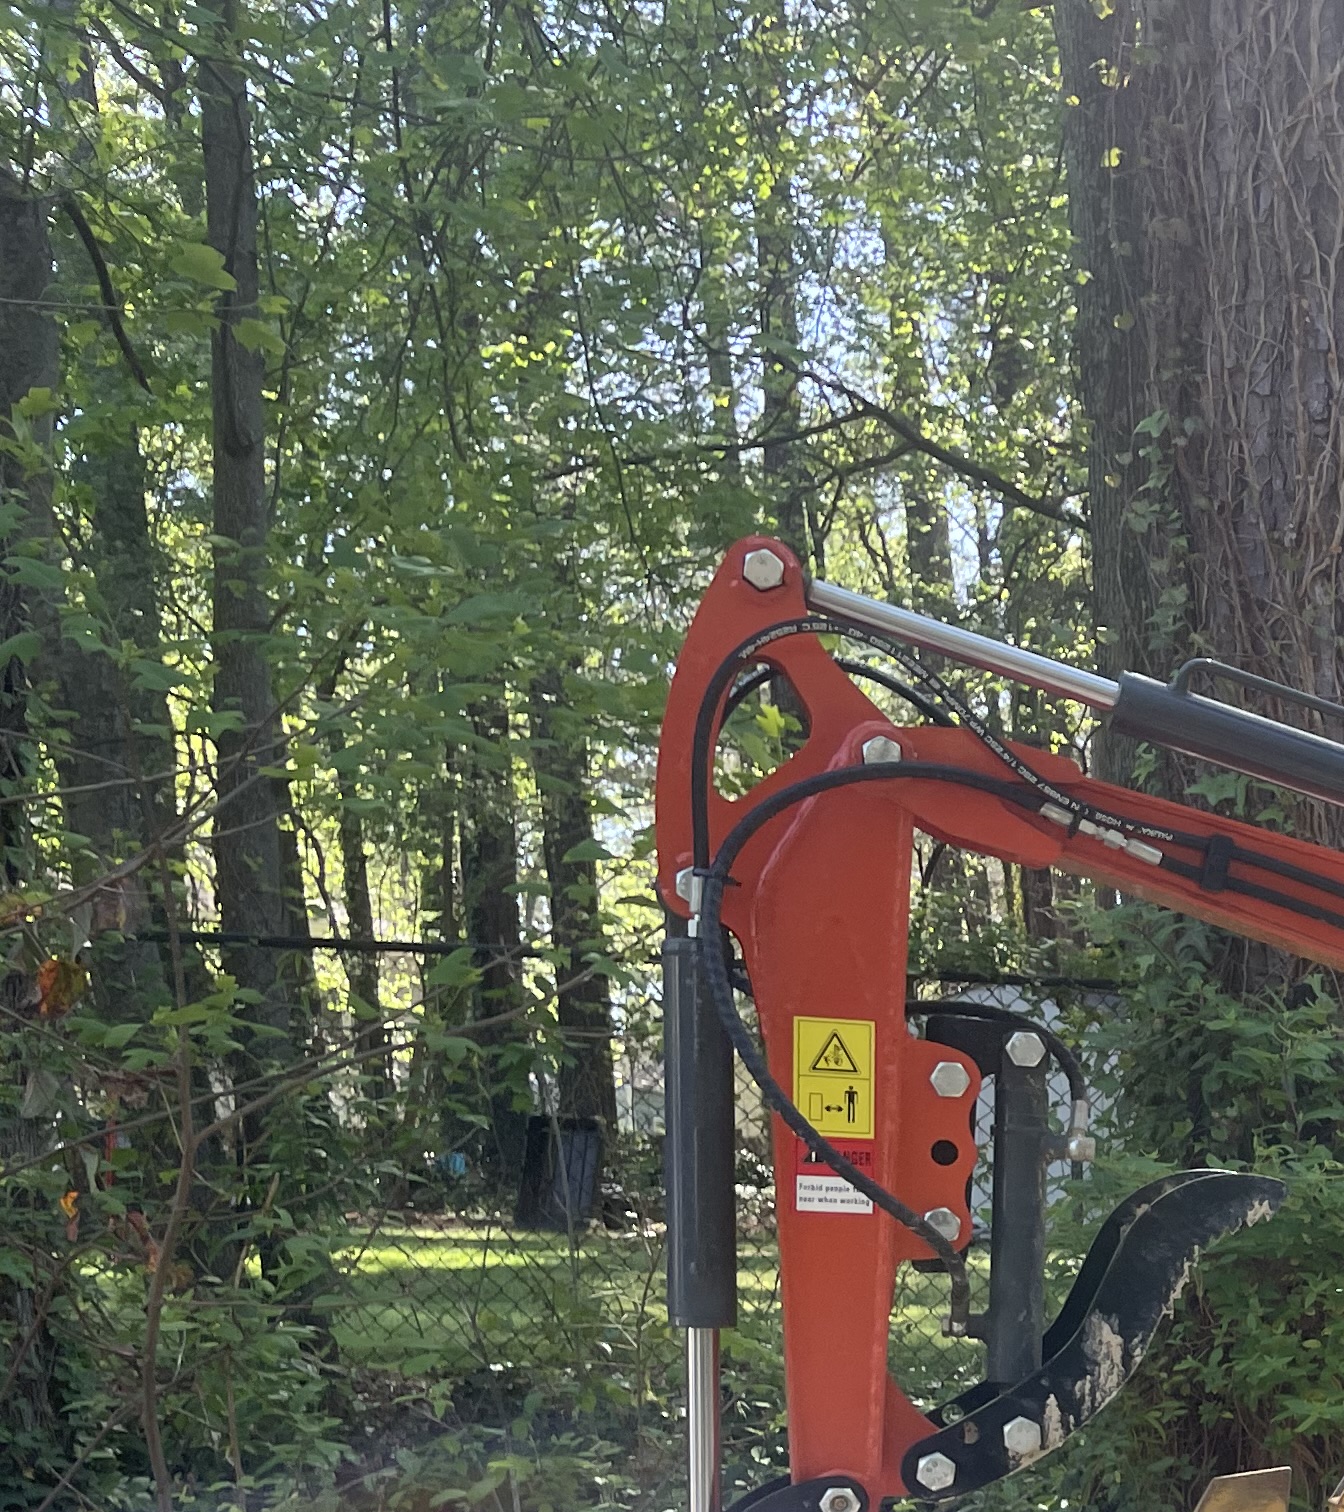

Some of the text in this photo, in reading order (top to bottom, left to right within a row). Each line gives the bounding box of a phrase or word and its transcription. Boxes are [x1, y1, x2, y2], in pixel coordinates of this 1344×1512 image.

[799, 1183, 823, 1191] Forbid
[825, 1185, 850, 1193] people
[818, 1196, 838, 1204] when
[839, 1198, 870, 1207] working
